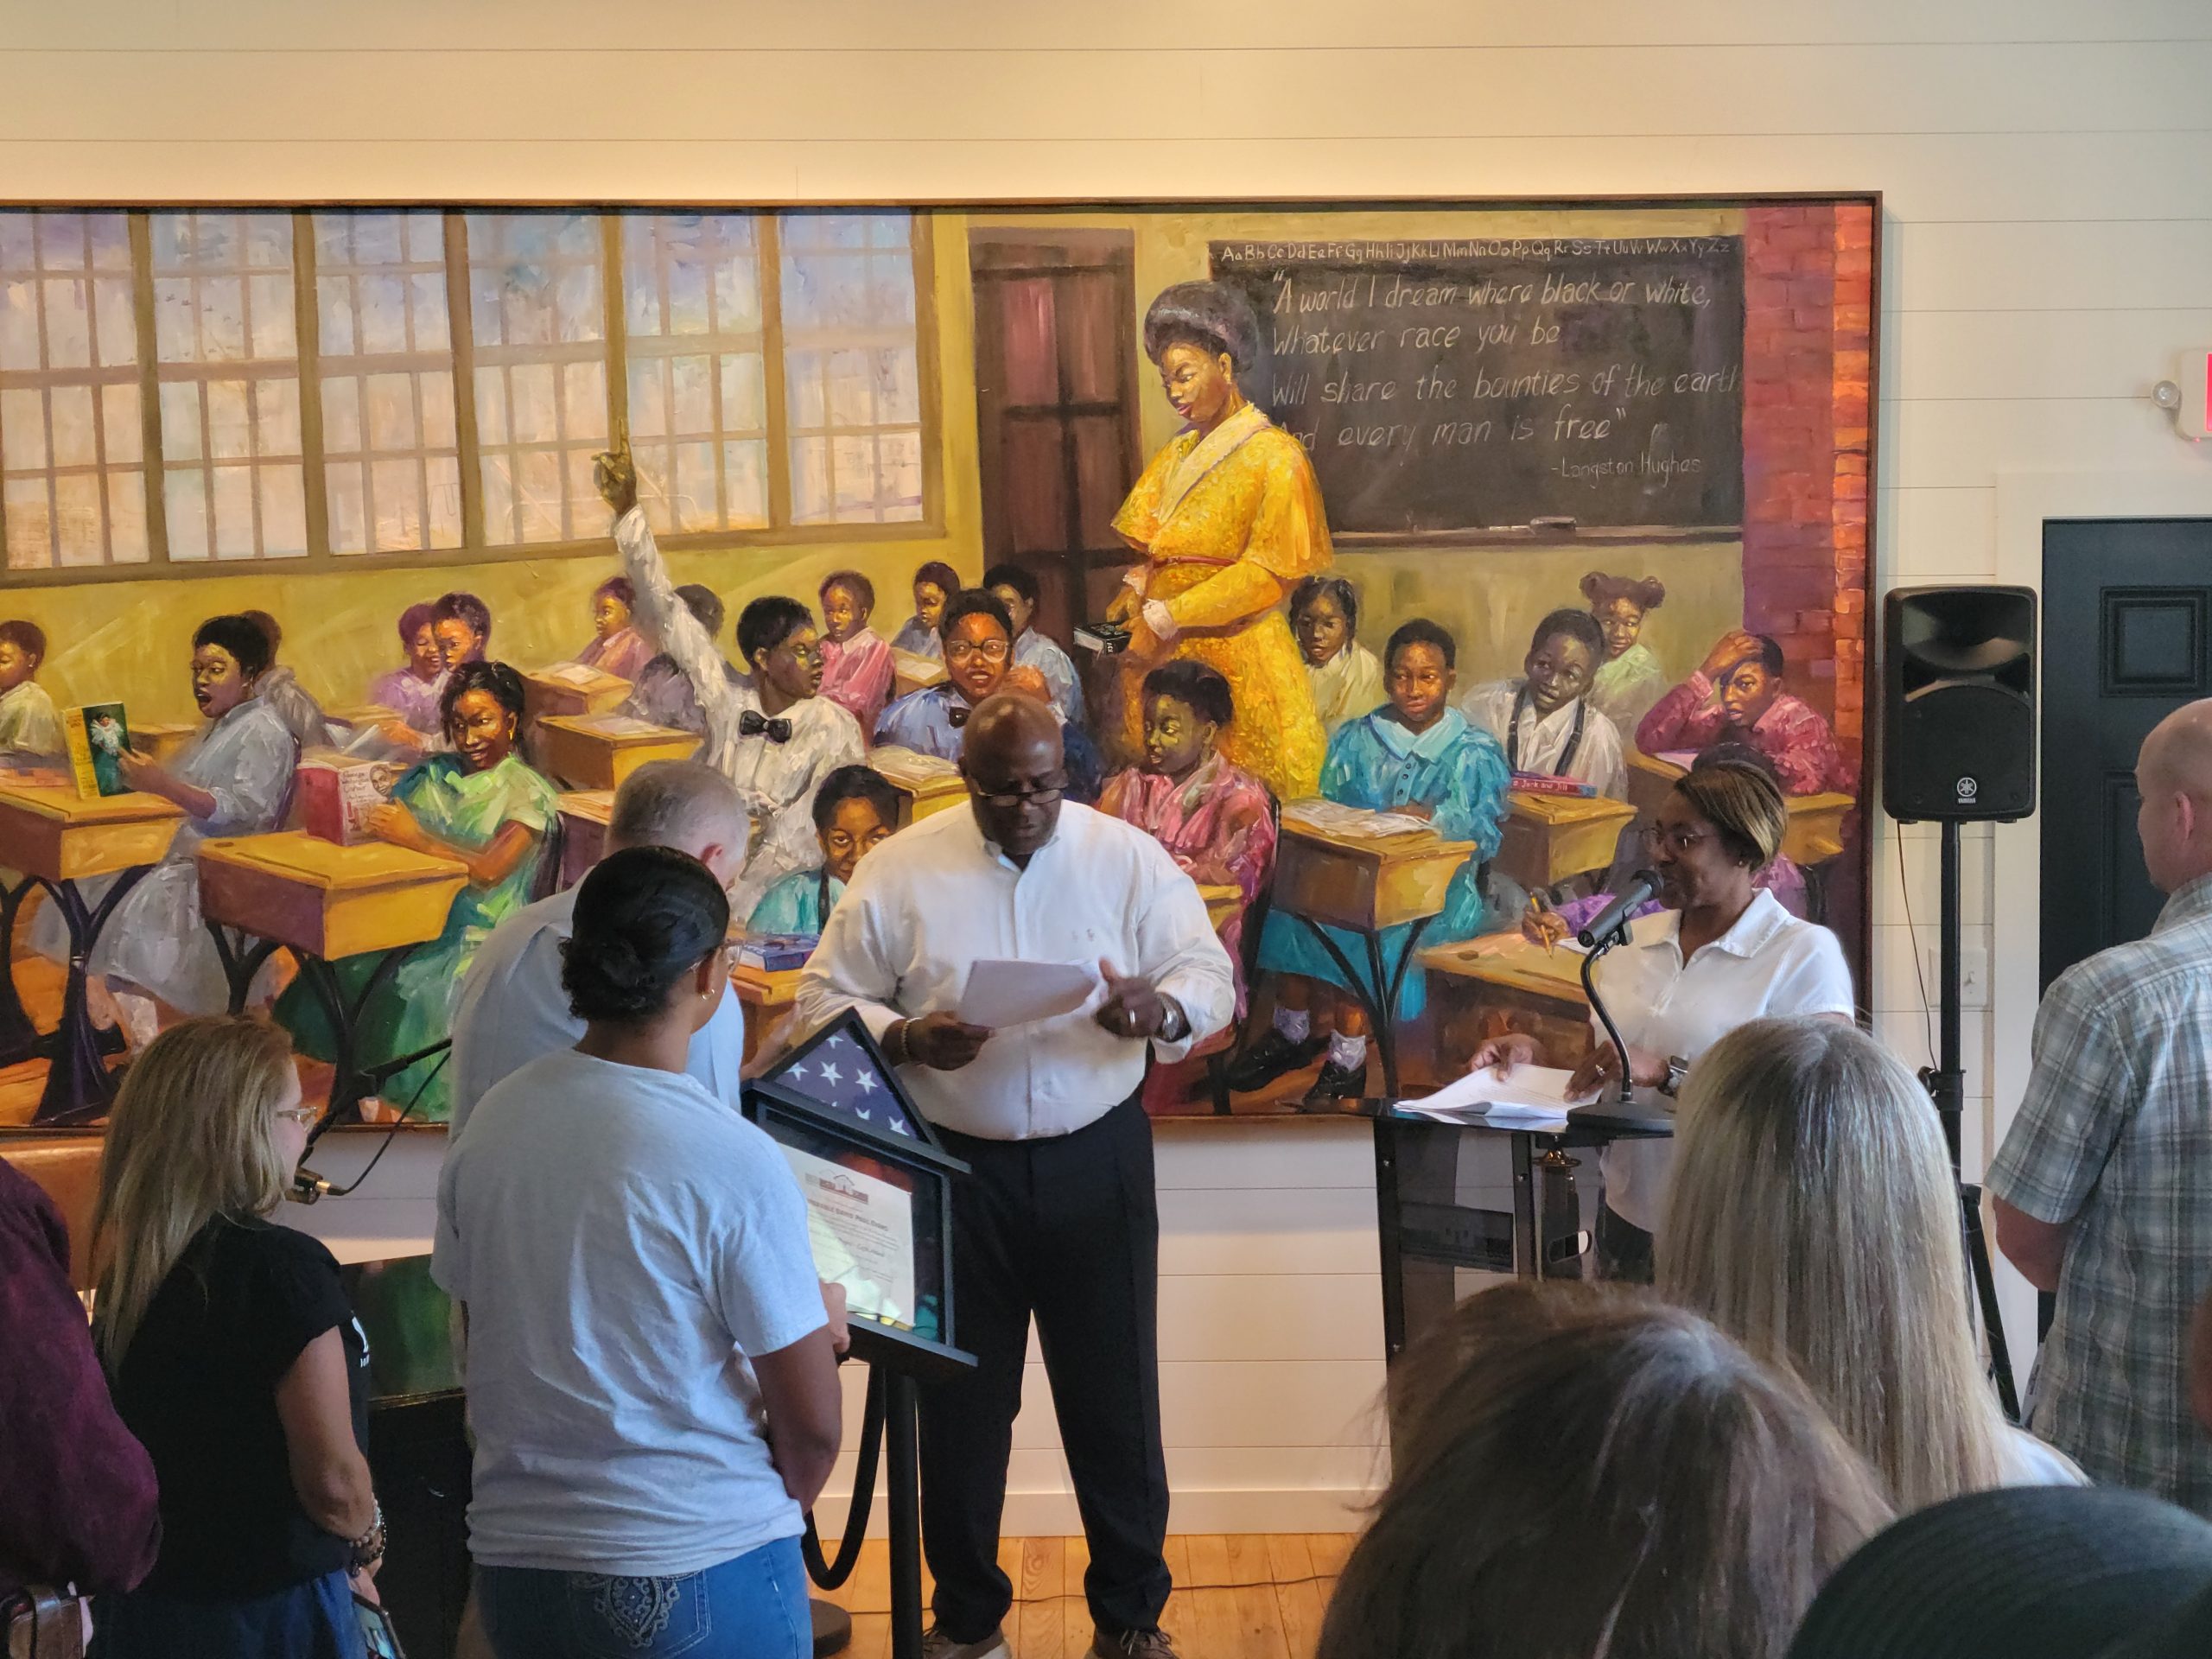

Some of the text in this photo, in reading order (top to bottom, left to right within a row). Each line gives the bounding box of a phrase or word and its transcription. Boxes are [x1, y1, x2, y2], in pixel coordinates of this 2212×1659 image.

[1300, 276, 1358, 313] world
[1368, 274, 1376, 308] I
[1384, 273, 1458, 308] dream
[1469, 278, 1535, 305] where
[1541, 272, 1601, 305] black
[1609, 281, 1635, 302] or
[1645, 275, 1711, 309] white,
[1273, 315, 1560, 356] Whatever race you be
[1272, 372, 1310, 406] Will
[1320, 367, 1396, 404] share
[1416, 364, 1458, 400] the
[1472, 365, 1580, 400] bounties
[1592, 363, 1621, 397] of
[1624, 362, 1664, 397] the
[1338, 424, 1416, 451] every
[1432, 420, 1492, 446] man
[1510, 415, 1535, 441] is
[1641, 449, 1701, 488] Hughes
